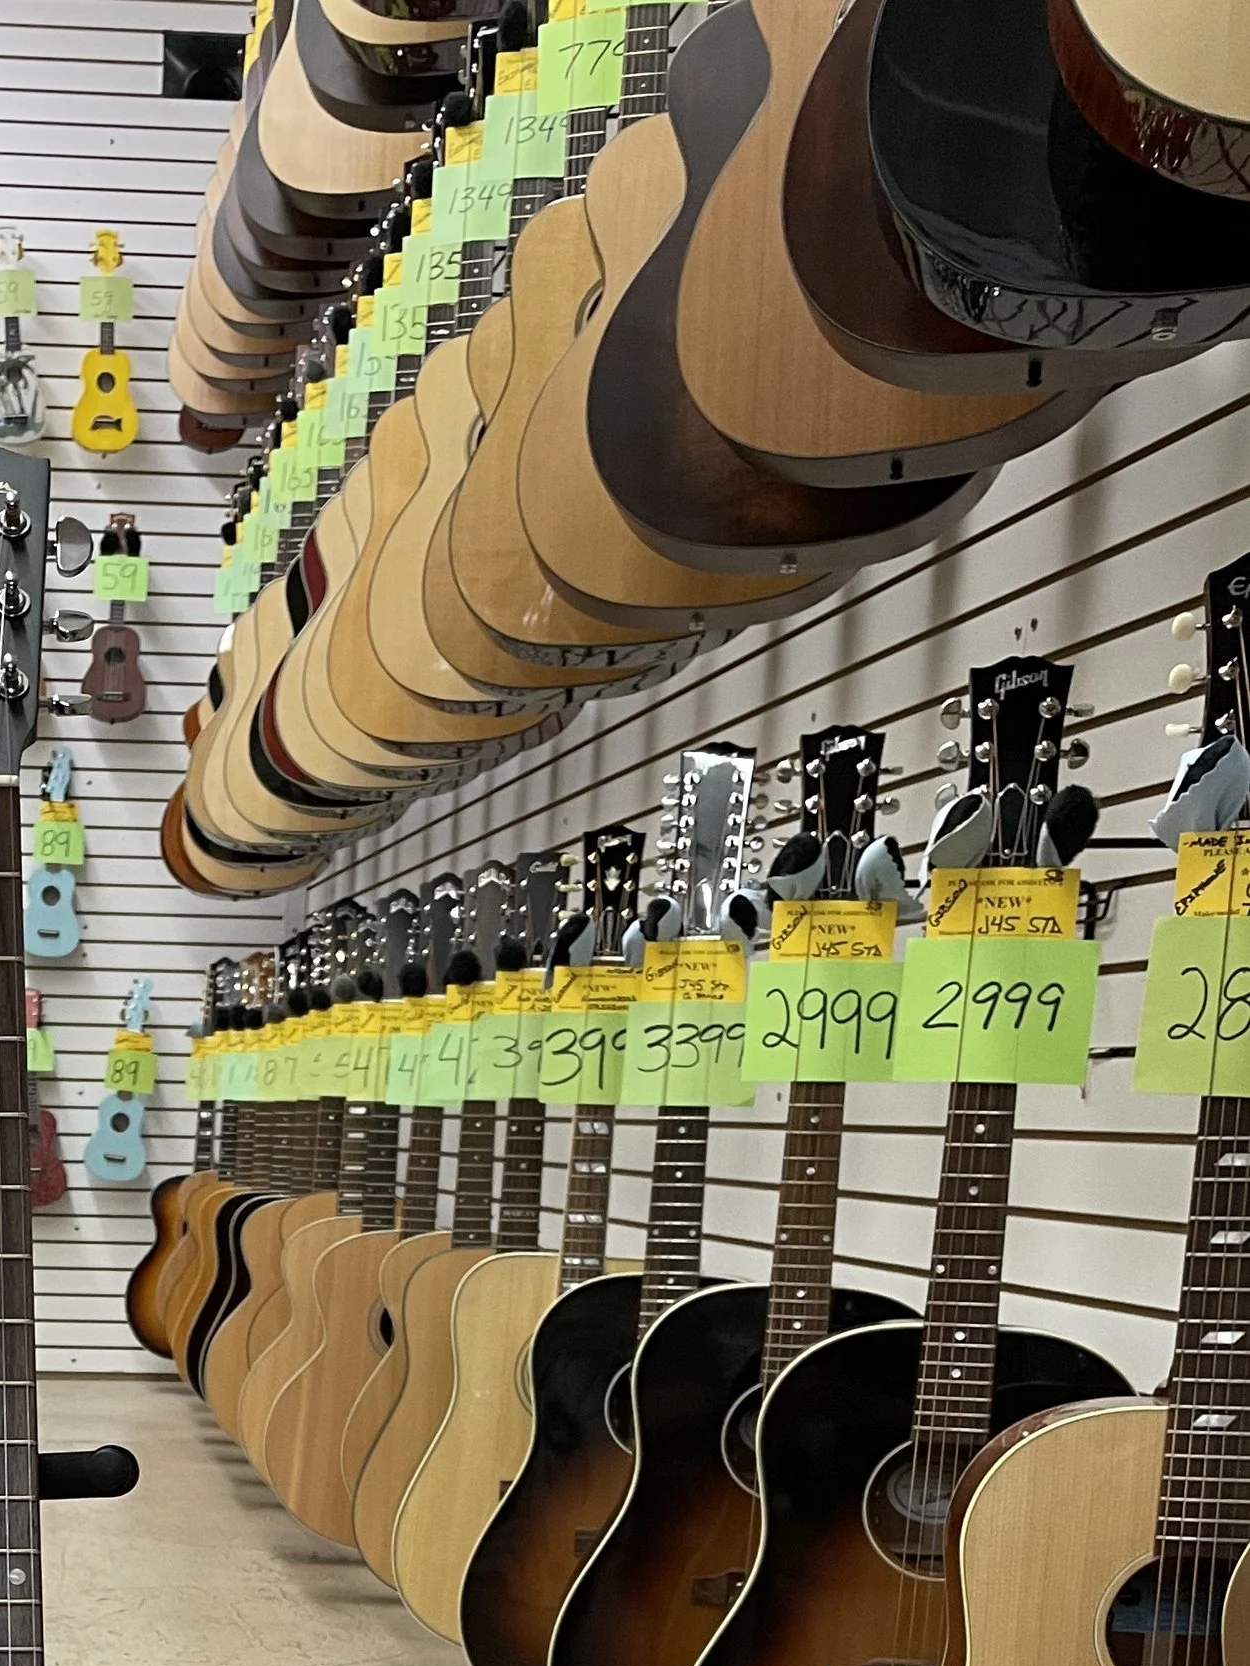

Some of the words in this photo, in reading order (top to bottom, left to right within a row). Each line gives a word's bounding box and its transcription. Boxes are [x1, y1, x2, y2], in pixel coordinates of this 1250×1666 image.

[449, 183, 513, 215] 1349
[90, 290, 115, 307] 59
[102, 562, 138, 592] 59
[995, 669, 1049, 700] Gibson
[40, 829, 71, 857] 89
[978, 914, 1020, 934] J45
[811, 941, 848, 957] J45
[922, 981, 1065, 1031] 2999
[1167, 966, 1250, 1041] 28
[762, 987, 899, 1060] 2999
[637, 1023, 745, 1073] 3399
[110, 1059, 140, 1085] 89
